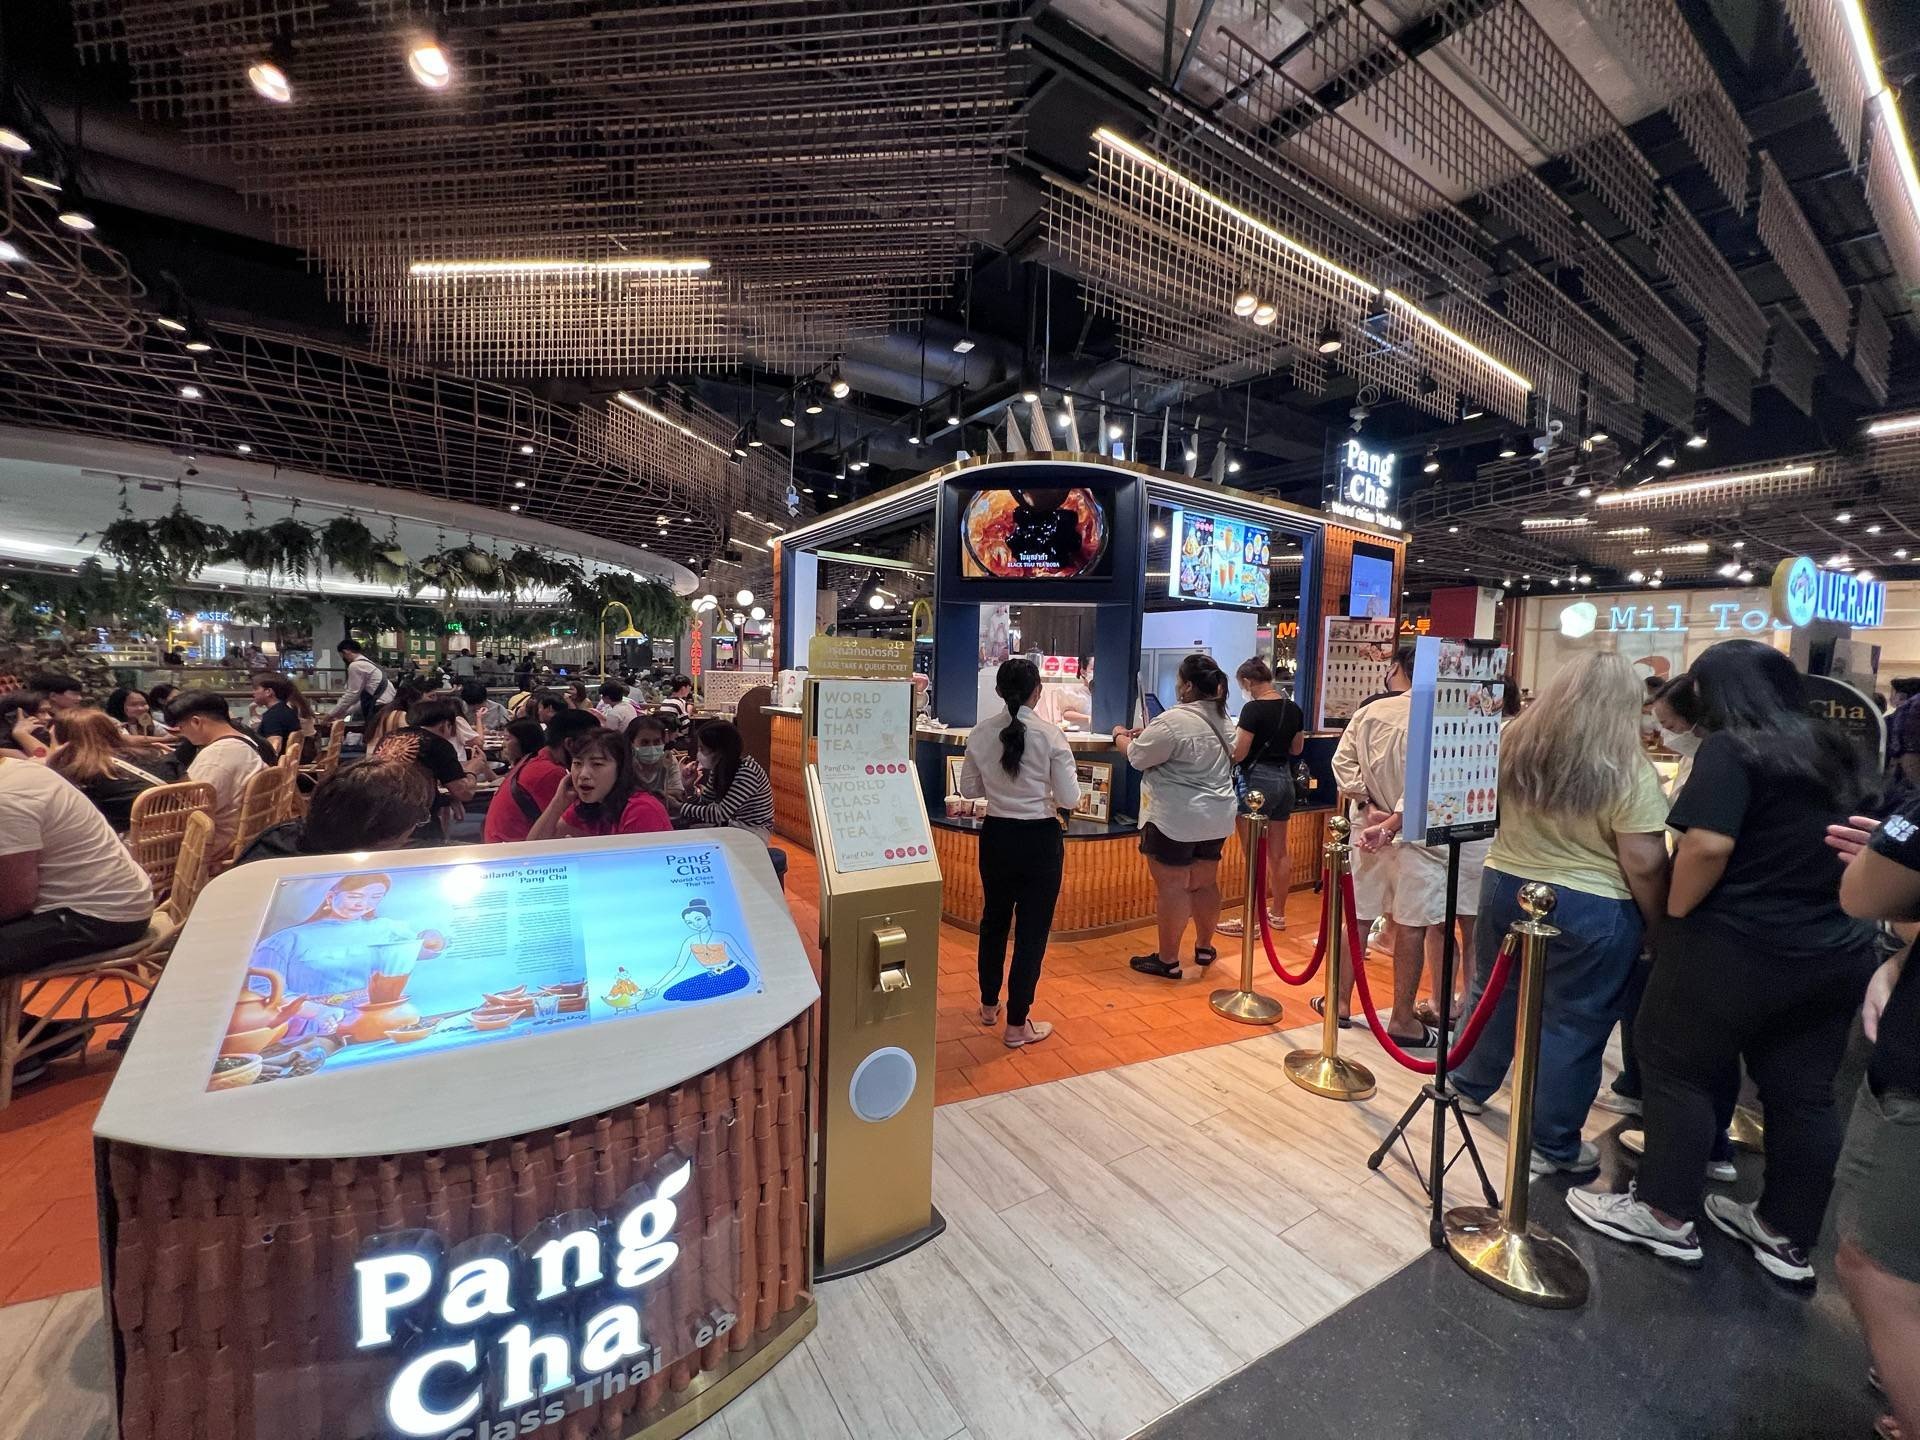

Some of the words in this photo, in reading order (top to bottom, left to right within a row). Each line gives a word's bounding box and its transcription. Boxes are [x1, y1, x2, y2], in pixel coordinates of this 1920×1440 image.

[1347, 439, 1395, 487] Pang
[1350, 474, 1389, 509] Cha
[1816, 570, 1883, 625] LUERJAI
[1608, 604, 1690, 632] Mil
[1709, 603, 1791, 633] To
[824, 692, 881, 704] WORLD
[824, 708, 872, 719] CLASS
[824, 723, 859, 735] THAI
[823, 739, 853, 751] TEA
[829, 779, 886, 793] WORLD
[831, 794, 880, 808] CLASS
[833, 810, 872, 823] THAI
[836, 826, 868, 839] TEA
[665, 852, 711, 866] Pang
[480, 869, 523, 880] ailand's
[526, 866, 567, 876] Original
[676, 864, 711, 876] Cha
[520, 875, 545, 884] Pang
[353, 1159, 692, 1350] Pang
[386, 1303, 651, 1437] Cha
[575, 1348, 663, 1409] Thai
